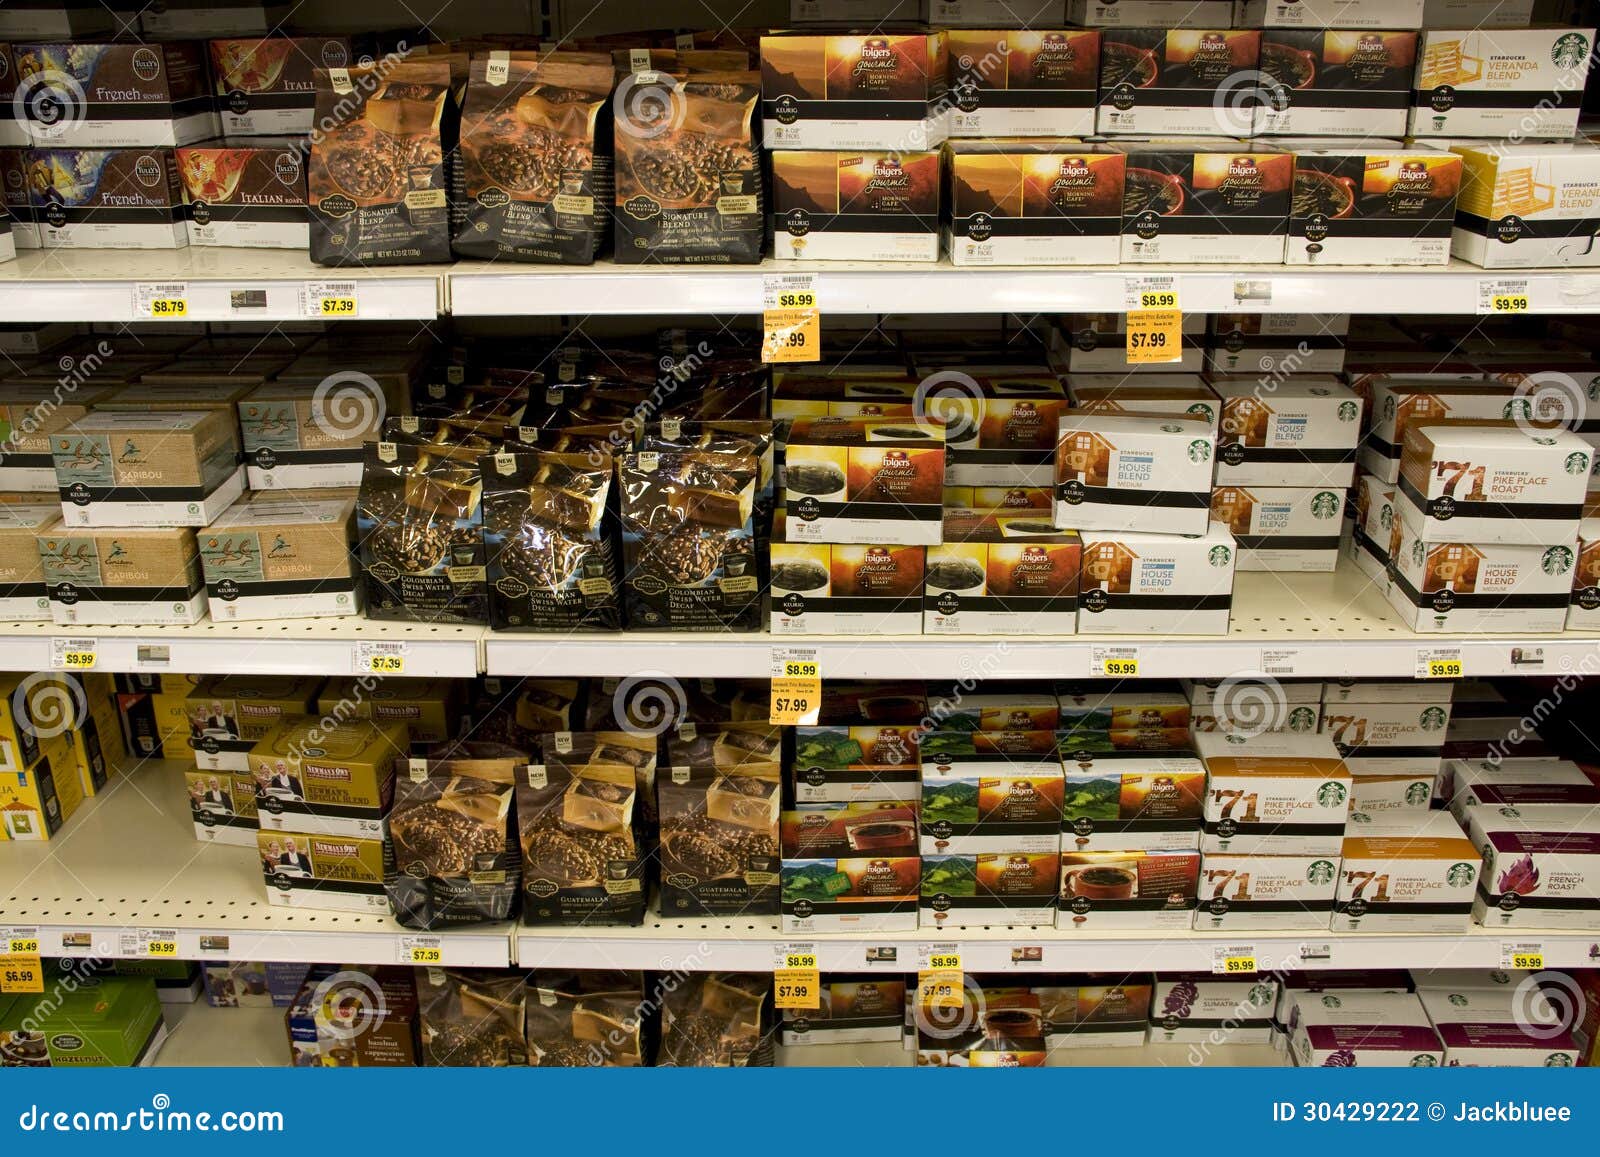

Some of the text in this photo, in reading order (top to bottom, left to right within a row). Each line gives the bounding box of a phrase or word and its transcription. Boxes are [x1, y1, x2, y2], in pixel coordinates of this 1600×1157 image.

[1041, 40, 1068, 51] Folgers
[1200, 39, 1227, 51] Folgers
[1357, 40, 1384, 52] Folgers
[862, 47, 891, 59] Folgers
[853, 56, 897, 76] gourmet
[1488, 62, 1539, 70] VERANDA
[1486, 72, 1521, 80] BLEND
[96, 87, 141, 101] French
[874, 165, 903, 177] Folgers
[1059, 164, 1089, 177] Folgers
[1229, 163, 1257, 176] Folgers
[1398, 168, 1428, 180] Folgers
[865, 174, 908, 193] gourmet
[1050, 174, 1095, 194] gourmet
[1218, 174, 1264, 193] gourmet
[1387, 179, 1433, 197] gourmet
[102, 193, 143, 206] French
[241, 192, 283, 203] ITALIAN
[509, 204, 546, 214] SIGNATURE
[1559, 200, 1593, 209] BLEND
[359, 207, 399, 218] SIGNATURE
[507, 212, 531, 220] BLEND
[662, 212, 708, 221] SIGNATURE
[359, 217, 385, 226] BLEND
[662, 220, 690, 228] BLEND
[780, 294, 813, 306] $8.99
[1142, 295, 1174, 306] $8.99
[1495, 299, 1527, 310] $9.99
[154, 301, 185, 313] $8.79
[323, 301, 354, 312] $7.39
[1131, 332, 1166, 348] $7.99
[1012, 407, 1037, 419] Folgers
[1276, 425, 1306, 433] HOUSE
[1275, 432, 1304, 441] BLEND
[883, 456, 910, 468] Folgers
[1118, 464, 1152, 472] HOUSE
[119, 471, 163, 479] CARIBOU
[1118, 472, 1150, 481] BLEND
[1493, 476, 1549, 485] PIKE PLACE
[1491, 485, 1525, 494] ROAST
[1004, 495, 1028, 505] Folgers
[1259, 520, 1288, 528] BLEND
[864, 553, 891, 564] Folgers
[1021, 552, 1048, 564] Folgers
[268, 564, 312, 573] CARIBOU
[1485, 569, 1518, 577] HOUSE
[106, 571, 149, 580] CARIBOU
[401, 575, 444, 584] COLOMBIAN
[1483, 577, 1515, 585] BLEND
[401, 583, 450, 591] SWISS WATER
[668, 587, 715, 596] COLOMBIAN
[402, 589, 425, 597] DECAF
[694, 594, 721, 602] WATER
[554, 598, 582, 606] WATER
[669, 601, 695, 609] DECAF
[532, 604, 556, 612] DECAF
[66, 654, 93, 665] $9.99
[372, 658, 401, 669] $7.39
[786, 665, 816, 675] $8.99
[1107, 663, 1136, 674] $9.99
[1431, 665, 1460, 675] $9.99
[776, 698, 808, 712] $7.99
[1009, 787, 1034, 795] Folgers
[1151, 783, 1175, 792] Folgers
[867, 865, 891, 874] Folgers
[1006, 862, 1030, 870] Folgers
[1549, 876, 1584, 884] FRENCH
[1547, 883, 1577, 891] ROAST
[12, 942, 37, 951] $8.49
[150, 943, 175, 952] $9.99
[414, 951, 439, 960] $7.39
[787, 957, 814, 967] $8.99
[931, 957, 958, 967] $8.99
[1228, 961, 1254, 970] $9.99
[1515, 957, 1541, 967] $9.99
[6, 972, 33, 982] $6.99
[779, 986, 807, 997] $7.99
[923, 985, 951, 996] $7.99
